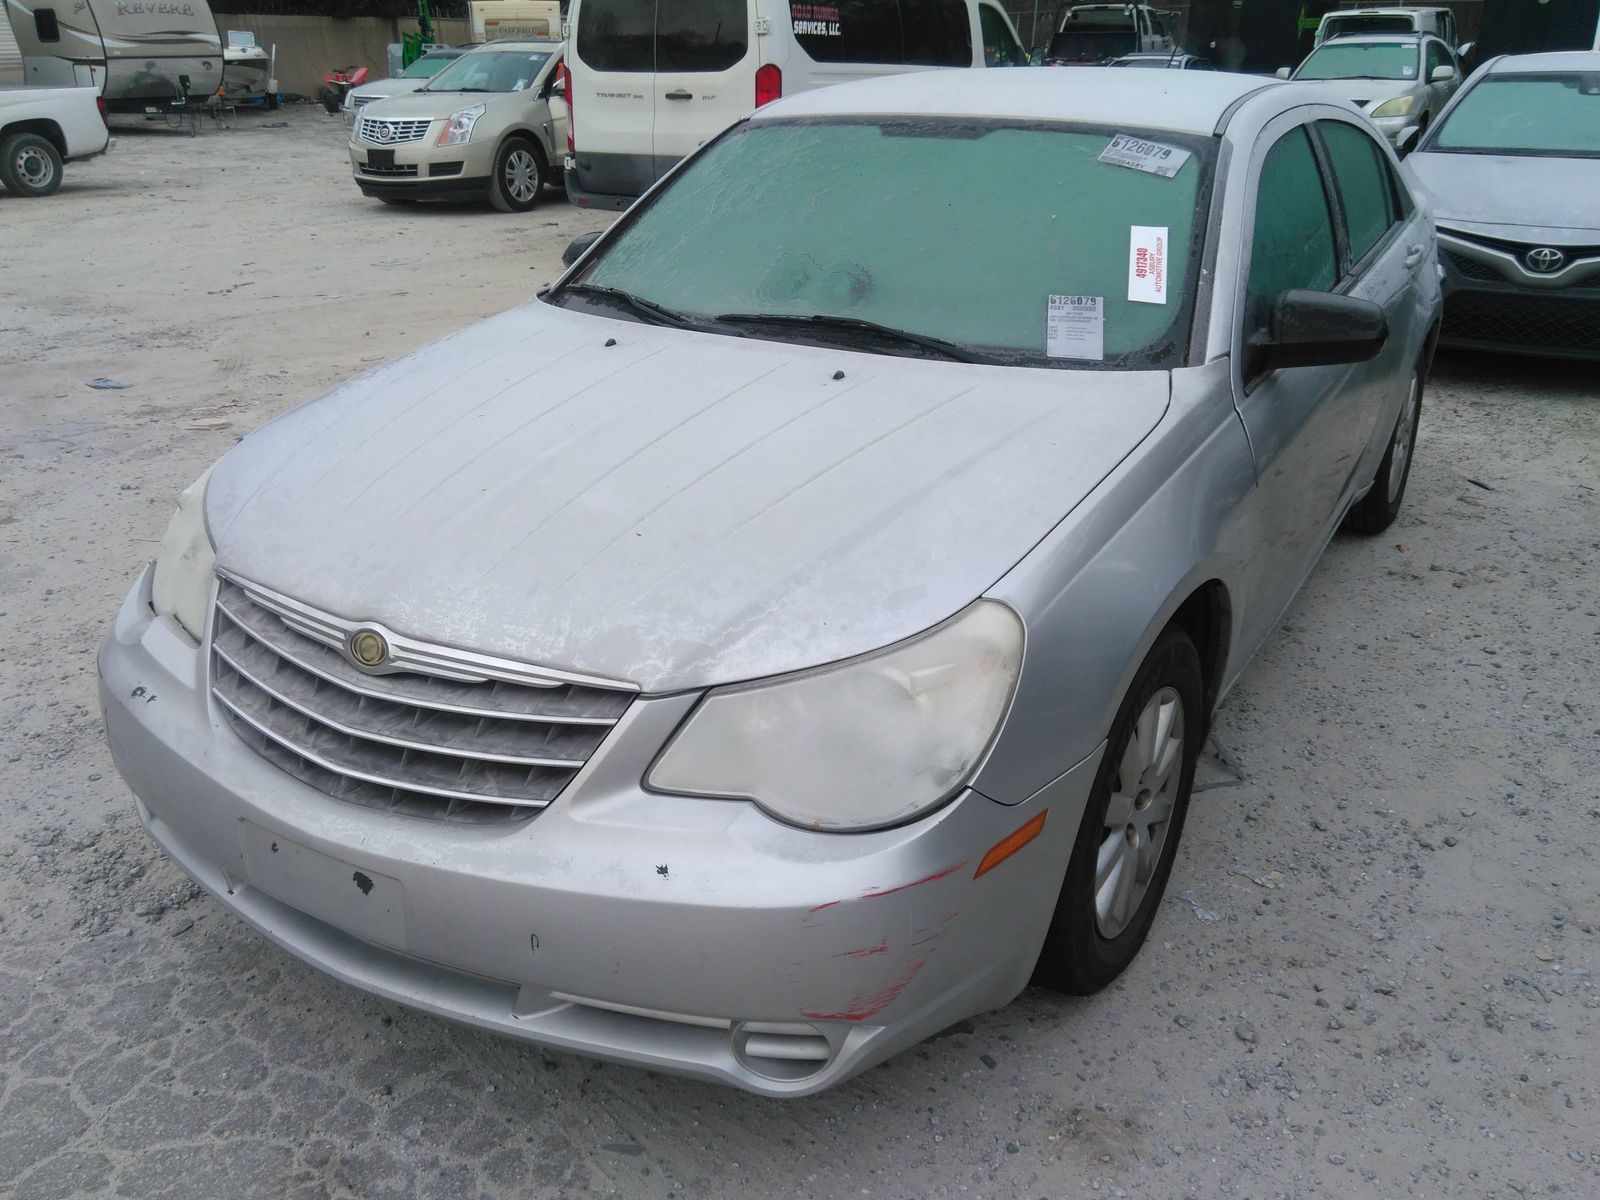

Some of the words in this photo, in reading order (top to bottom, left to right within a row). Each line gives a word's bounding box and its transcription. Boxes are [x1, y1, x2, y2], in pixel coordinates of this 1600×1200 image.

[116, 2, 194, 16] REVERE
[792, 4, 811, 19] ROAD
[1111, 137, 1172, 160] 6126079
[1156, 236, 1164, 256] GROUP
[1136, 247, 1148, 279] 4917340
[1155, 257, 1163, 294] AUTOMOTIVE
[1050, 296, 1097, 306] 6126079
